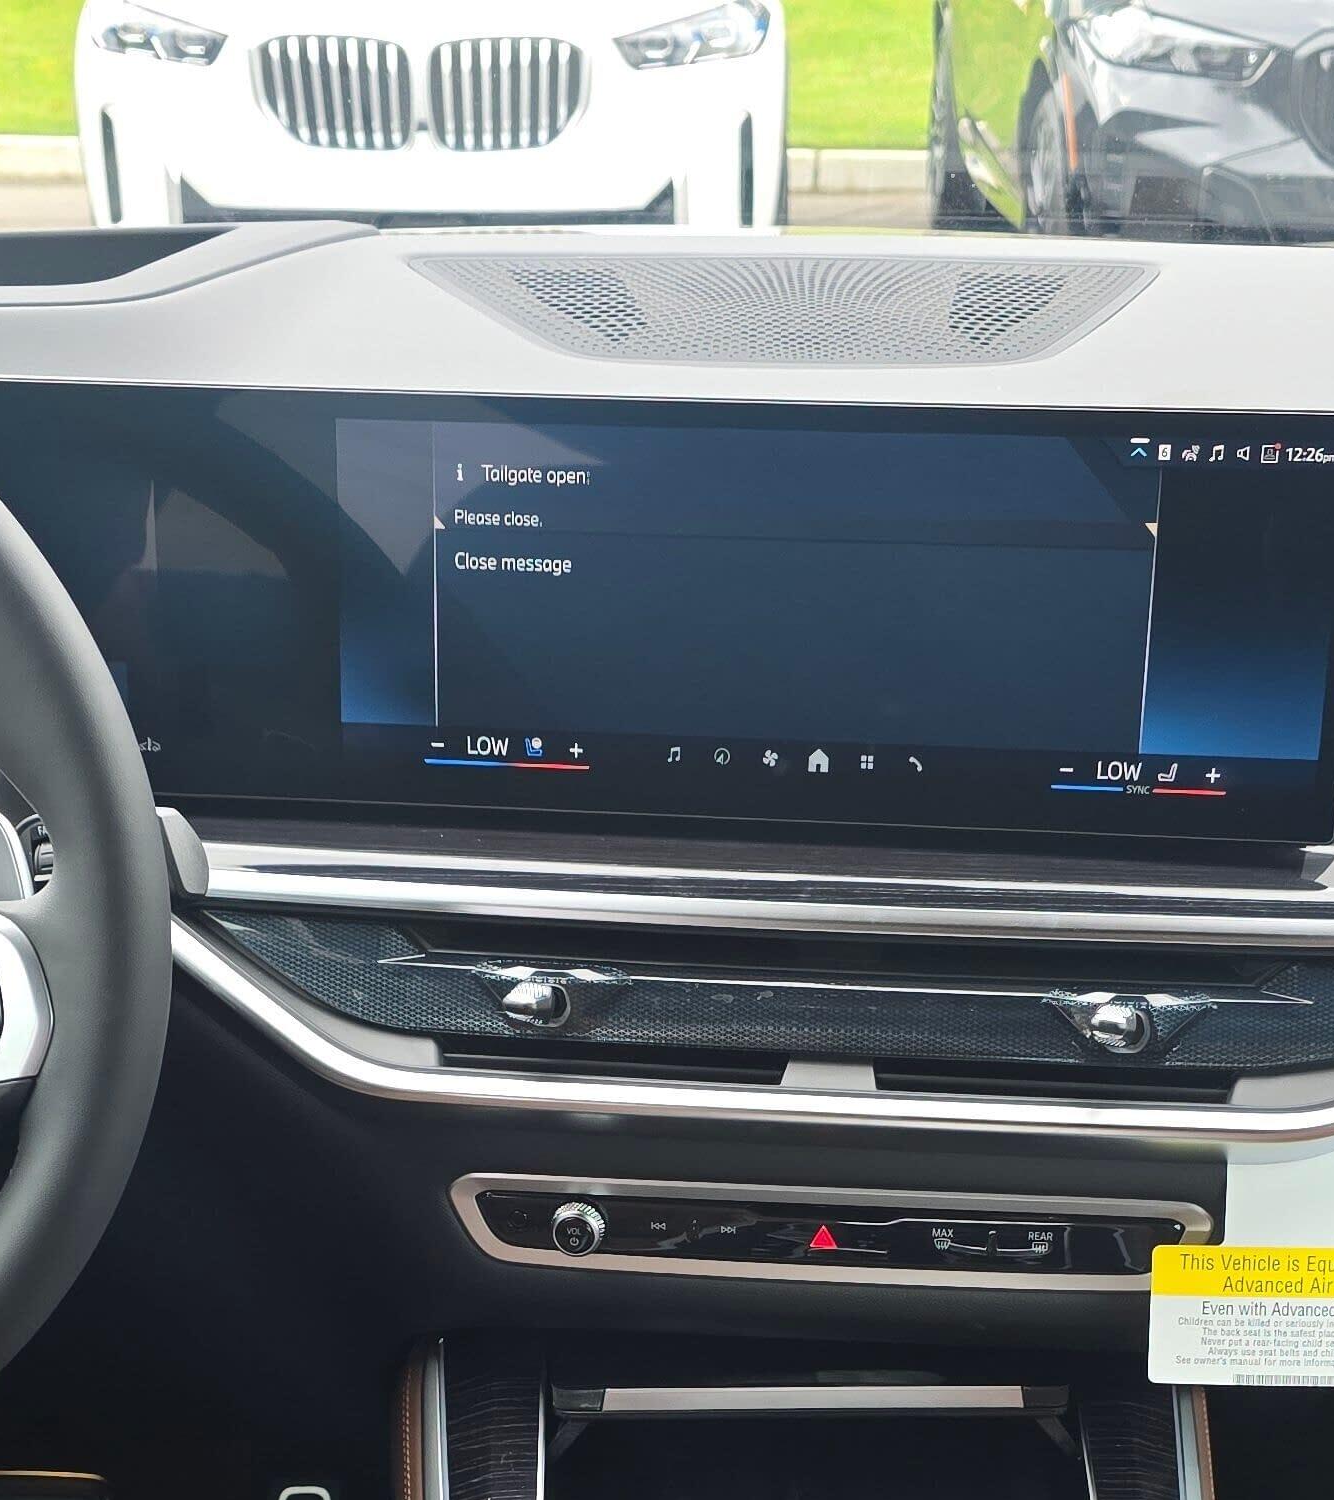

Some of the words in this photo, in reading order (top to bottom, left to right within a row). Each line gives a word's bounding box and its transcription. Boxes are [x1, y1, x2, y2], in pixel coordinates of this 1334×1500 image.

[481, 464, 542, 486] Tailgate
[454, 509, 500, 526] Please
[504, 511, 543, 527] close.
[454, 552, 497, 570] Close
[501, 557, 572, 577] message
[467, 735, 509, 756] LOW
[1096, 760, 1142, 782] LOW
[1126, 785, 1150, 795] SYNC
[566, 1227, 582, 1236] VOL
[931, 1227, 954, 1238] MAX
[1028, 1231, 1054, 1241] REAR
[1180, 1253, 1214, 1271] This
[1221, 1254, 1280, 1272] Vehicle
[1287, 1255, 1299, 1272] is
[1223, 1276, 1303, 1294] Advanced
[1310, 1277, 1333, 1294] Air
[1202, 1301, 1234, 1316] Even
[1238, 1301, 1267, 1316] with
[1178, 1316, 1214, 1326] Children
[1217, 1318, 1231, 1327] can
[1234, 1318, 1245, 1327] be
[1248, 1318, 1271, 1328] killed
[1285, 1319, 1324, 1329] seriously
[1202, 1327, 1218, 1336] The
[1220, 1328, 1240, 1336] back
[1243, 1328, 1261, 1337] seat
[1263, 1328, 1271, 1337] is
[1273, 1328, 1288, 1337] the
[1290, 1329, 1316, 1338] safest
[1200, 1337, 1225, 1346] Never
[1228, 1338, 1242, 1348] put
[1252, 1338, 1299, 1349] rear-facing
[1302, 1339, 1322, 1348] child
[1208, 1347, 1238, 1357] Always
[1258, 1348, 1277, 1357] seat
[1279, 1348, 1300, 1357] belts
[1302, 1348, 1318, 1357] and
[1175, 1355, 1191, 1365] See
[1193, 1356, 1227, 1366] owner's
[1230, 1358, 1261, 1366] manual
[1264, 1357, 1277, 1366] for
[1279, 1359, 1300, 1367] more
